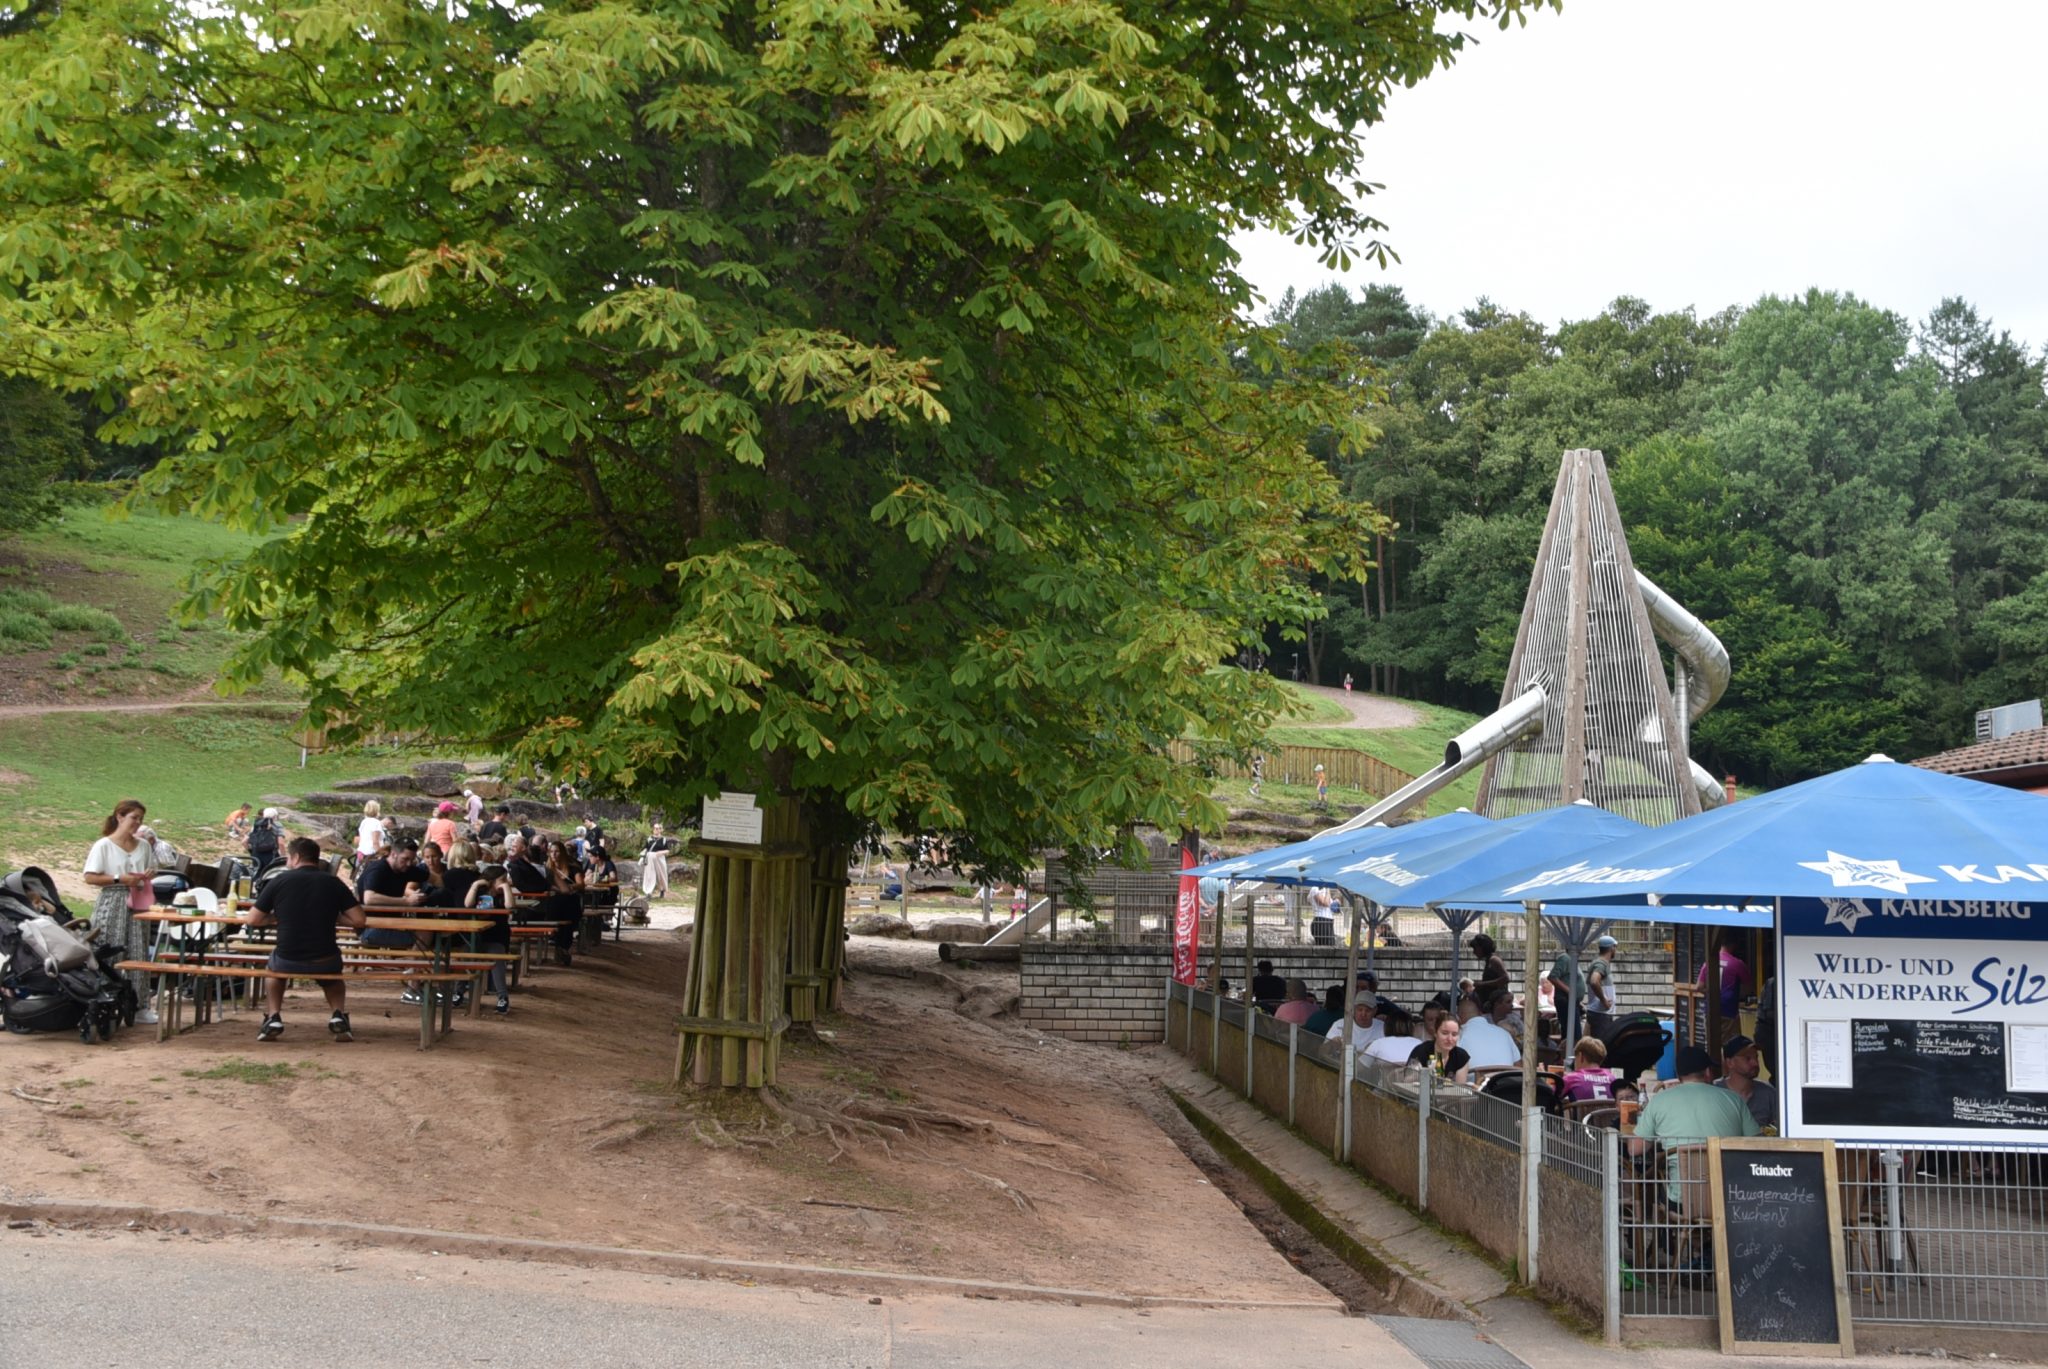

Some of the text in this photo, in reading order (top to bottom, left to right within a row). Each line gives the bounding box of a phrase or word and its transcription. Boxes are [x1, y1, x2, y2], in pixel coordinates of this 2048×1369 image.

[1881, 898, 2031, 919] KARLSBERG
[1814, 953, 1954, 976] WILD- UND
[1798, 956, 2048, 1015] WANDERPARK Silz
[1728, 1184, 1815, 1207] Hausgemachte
